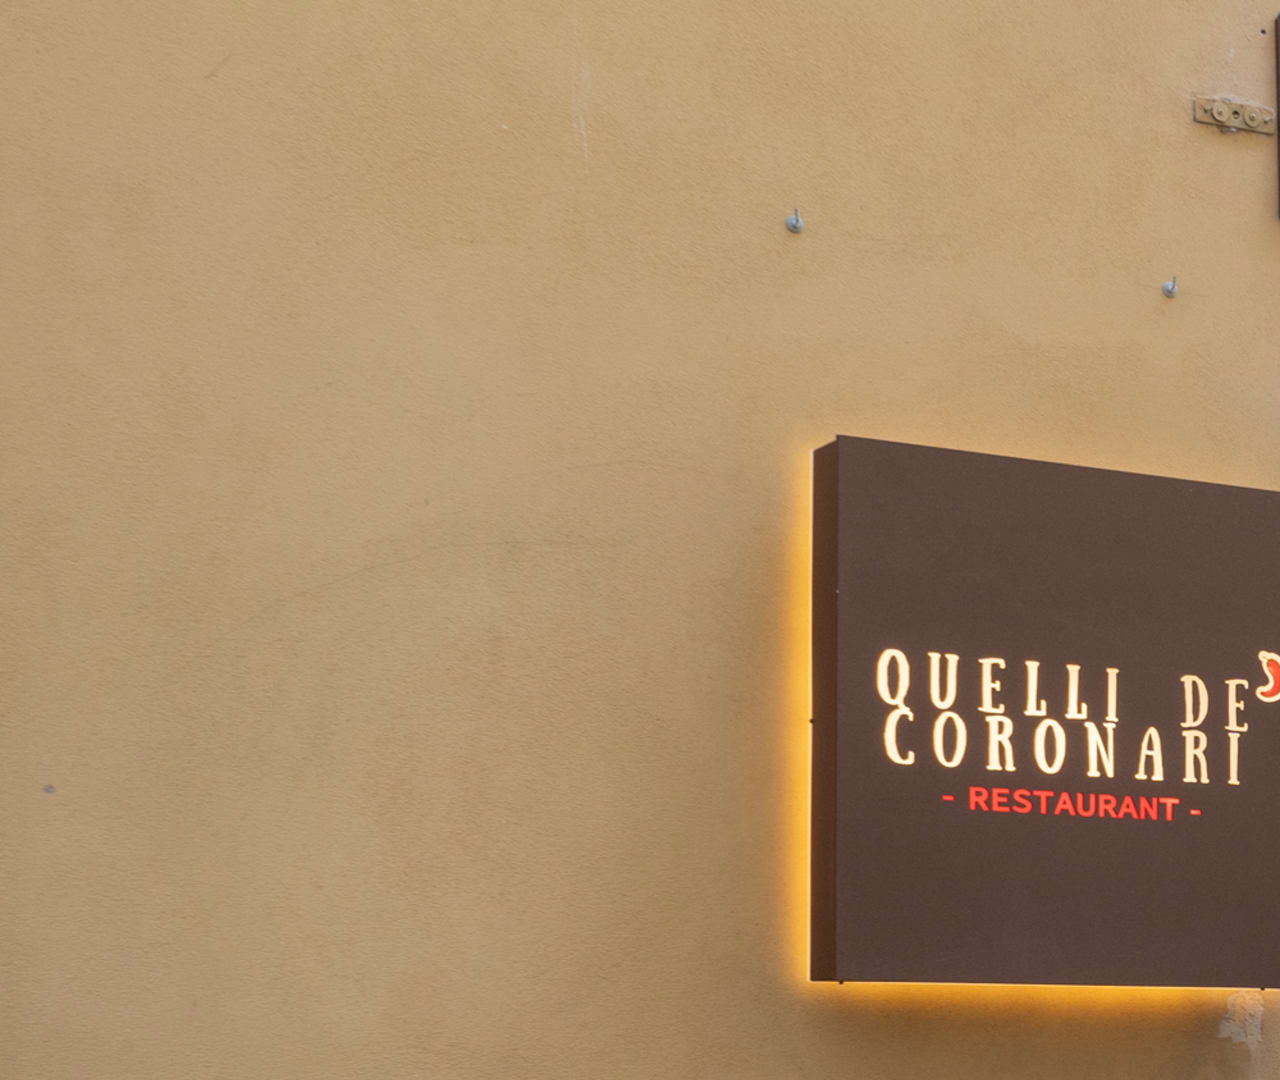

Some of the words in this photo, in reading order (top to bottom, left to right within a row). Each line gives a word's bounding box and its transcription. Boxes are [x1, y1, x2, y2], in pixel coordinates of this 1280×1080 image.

[876, 648, 1121, 723] QUELLI
[882, 708, 1241, 786] CORONARI
[968, 785, 1181, 822] RESTAURANT
